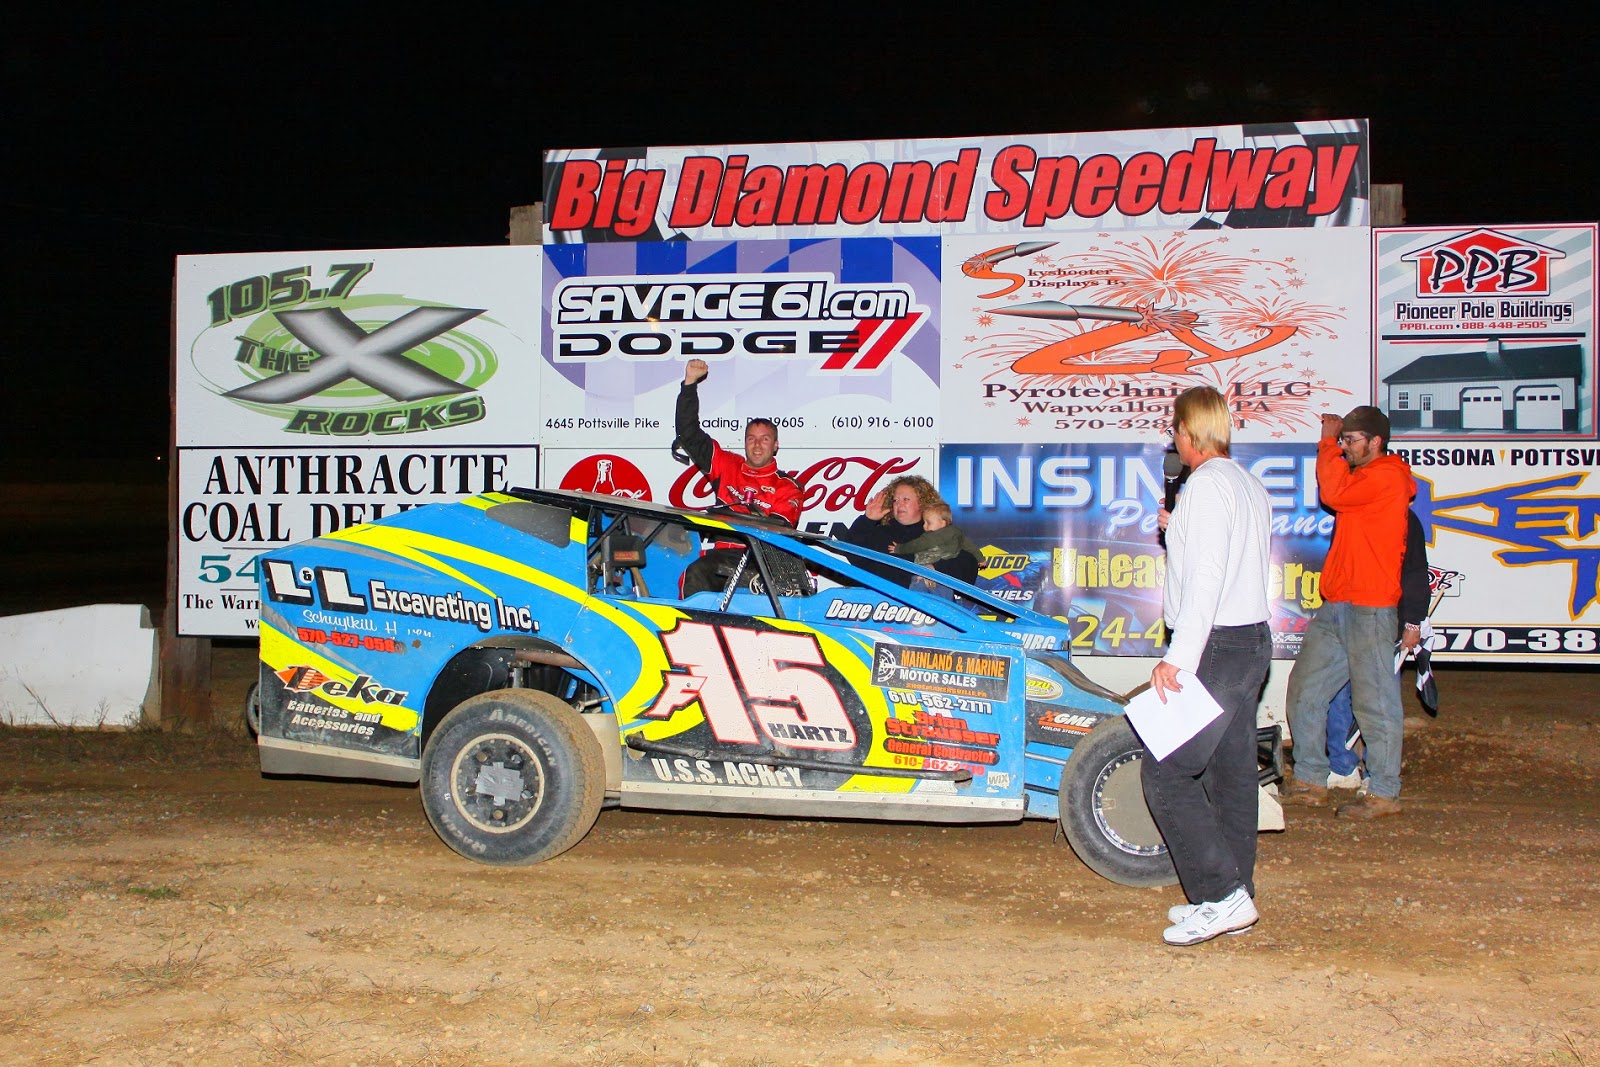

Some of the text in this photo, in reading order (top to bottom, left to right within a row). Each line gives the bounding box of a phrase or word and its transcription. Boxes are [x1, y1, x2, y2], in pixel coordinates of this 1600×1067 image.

[549, 136, 1360, 238] Big Diamond Speedway
[1430, 247, 1539, 291] PPB
[206, 262, 374, 328] 105.7
[1028, 279, 1104, 289] Displays
[558, 280, 910, 322] SAVAGE 61.com
[1396, 300, 1573, 322] Pioneer Pole Buildings
[1399, 320, 1548, 331] PPB1.com 888-448-2505
[220, 306, 489, 404] X
[234, 335, 313, 374] THE
[559, 330, 859, 357] DODGE
[983, 381, 1312, 402] Pyrotechni LLC
[283, 395, 487, 437] ROCKS
[1022, 400, 1272, 416] Wapwallop PA
[546, 418, 574, 430] 4645
[578, 417, 630, 430] Pottsville
[634, 417, 660, 430] Pike
[701, 417, 743, 431] ading,
[768, 417, 804, 429] 19605
[831, 415, 863, 430] (610)
[867, 417, 891, 430] 916
[902, 416, 934, 429] 6100
[1387, 449, 1496, 466] RESSONA
[203, 454, 509, 495] ANTHRACITE
[182, 502, 291, 543] COAL
[1053, 547, 1164, 588] Unlea
[182, 593, 214, 610] The
[261, 558, 541, 632] L&L Excavating Inc.
[302, 609, 378, 632] Schuylkill
[825, 598, 874, 621] Dave
[297, 627, 405, 653] 570-527-058
[901, 649, 1006, 678] MAINLAND & MARINE
[274, 665, 409, 707] Deka
[899, 668, 978, 688] MOTOR SALES
[287, 699, 381, 724] Batteries and
[887, 689, 992, 716] 610-562-2777
[291, 713, 375, 735] Accessories
[766, 722, 853, 744] HARTZ
[885, 717, 1001, 748] Strausser
[914, 710, 968, 731] Brian
[887, 738, 997, 764] General Contractor
[650, 757, 805, 788] U.S.S. ACHEY
[988, 774, 1009, 785] WIX
